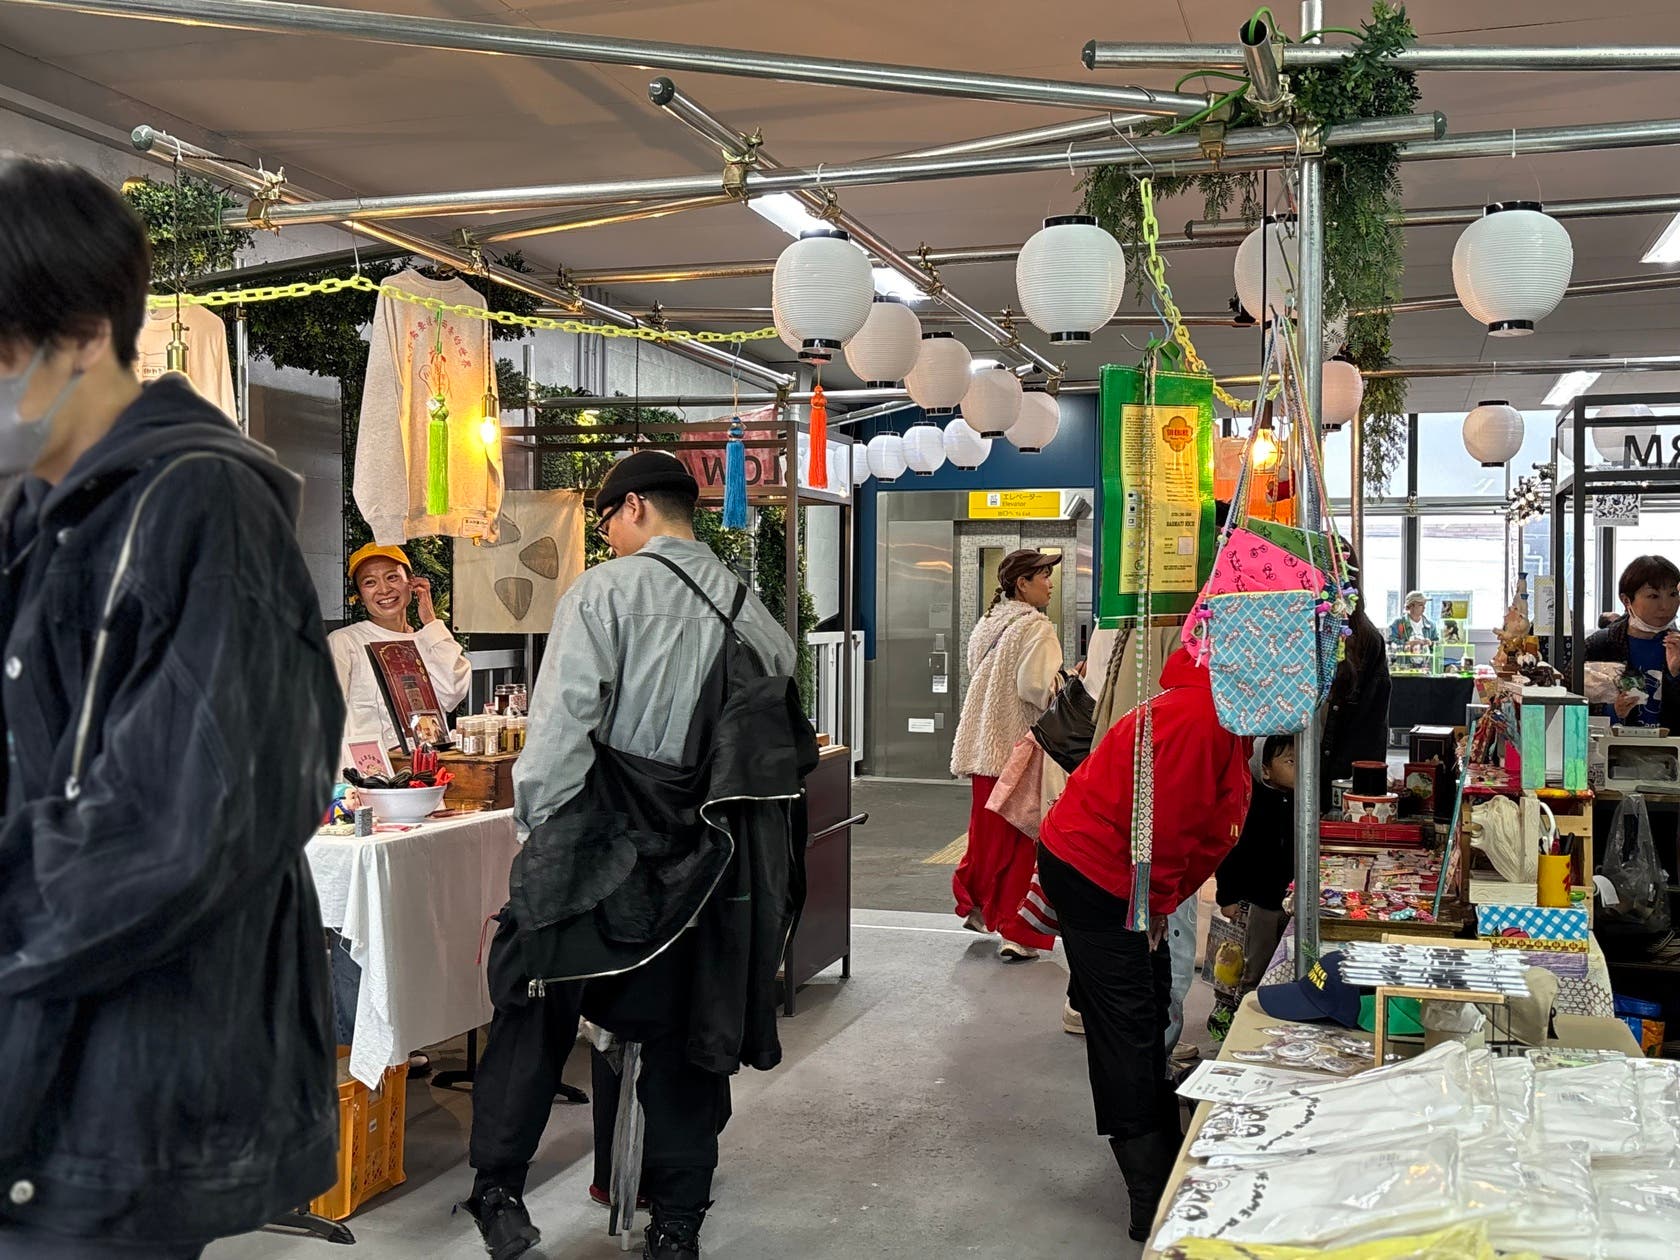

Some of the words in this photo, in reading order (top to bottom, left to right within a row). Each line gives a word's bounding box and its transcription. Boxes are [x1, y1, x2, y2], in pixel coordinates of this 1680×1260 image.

[1003, 493, 1042, 501] エレベーター
[1238, 1182, 1268, 1219] SAME
